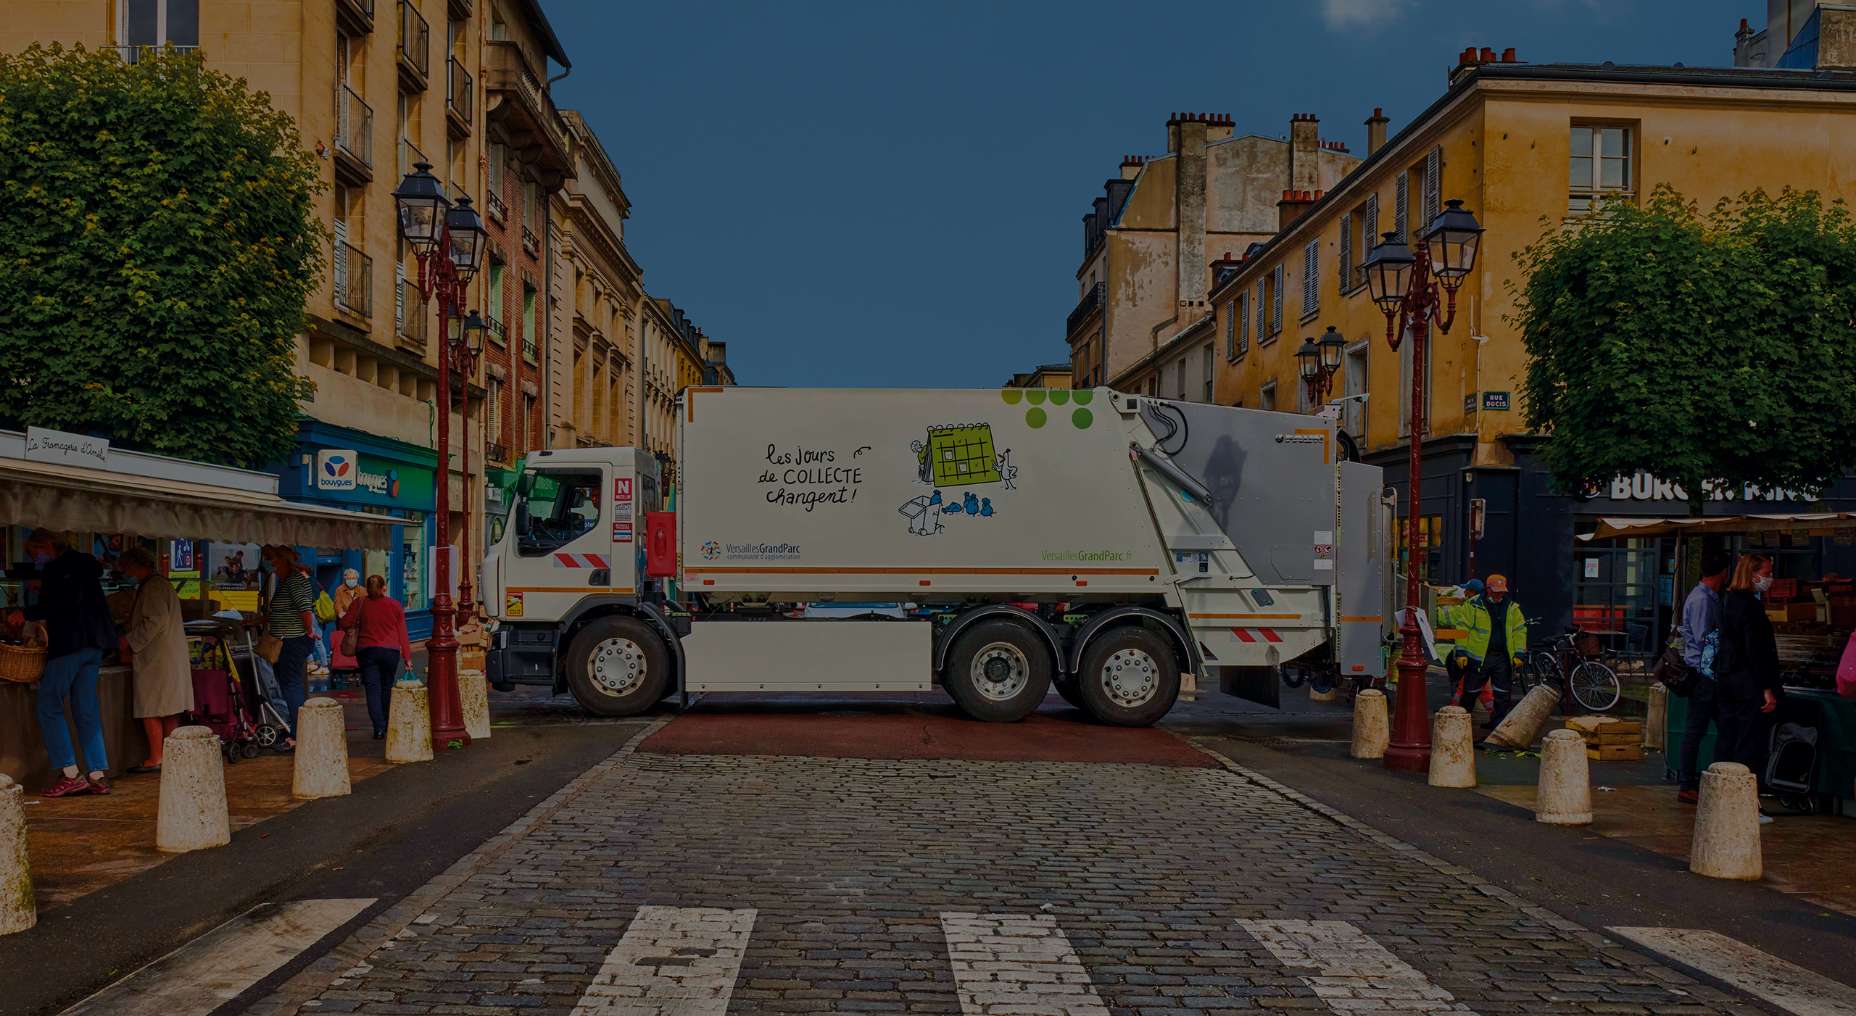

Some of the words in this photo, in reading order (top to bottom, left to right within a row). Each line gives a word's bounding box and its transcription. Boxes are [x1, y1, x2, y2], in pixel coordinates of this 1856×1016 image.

[766, 443, 792, 465] les
[795, 445, 836, 465] jours
[320, 478, 353, 487] bouygues
[758, 469, 778, 483] de
[783, 466, 863, 485] COLLECTE
[617, 480, 630, 495] N
